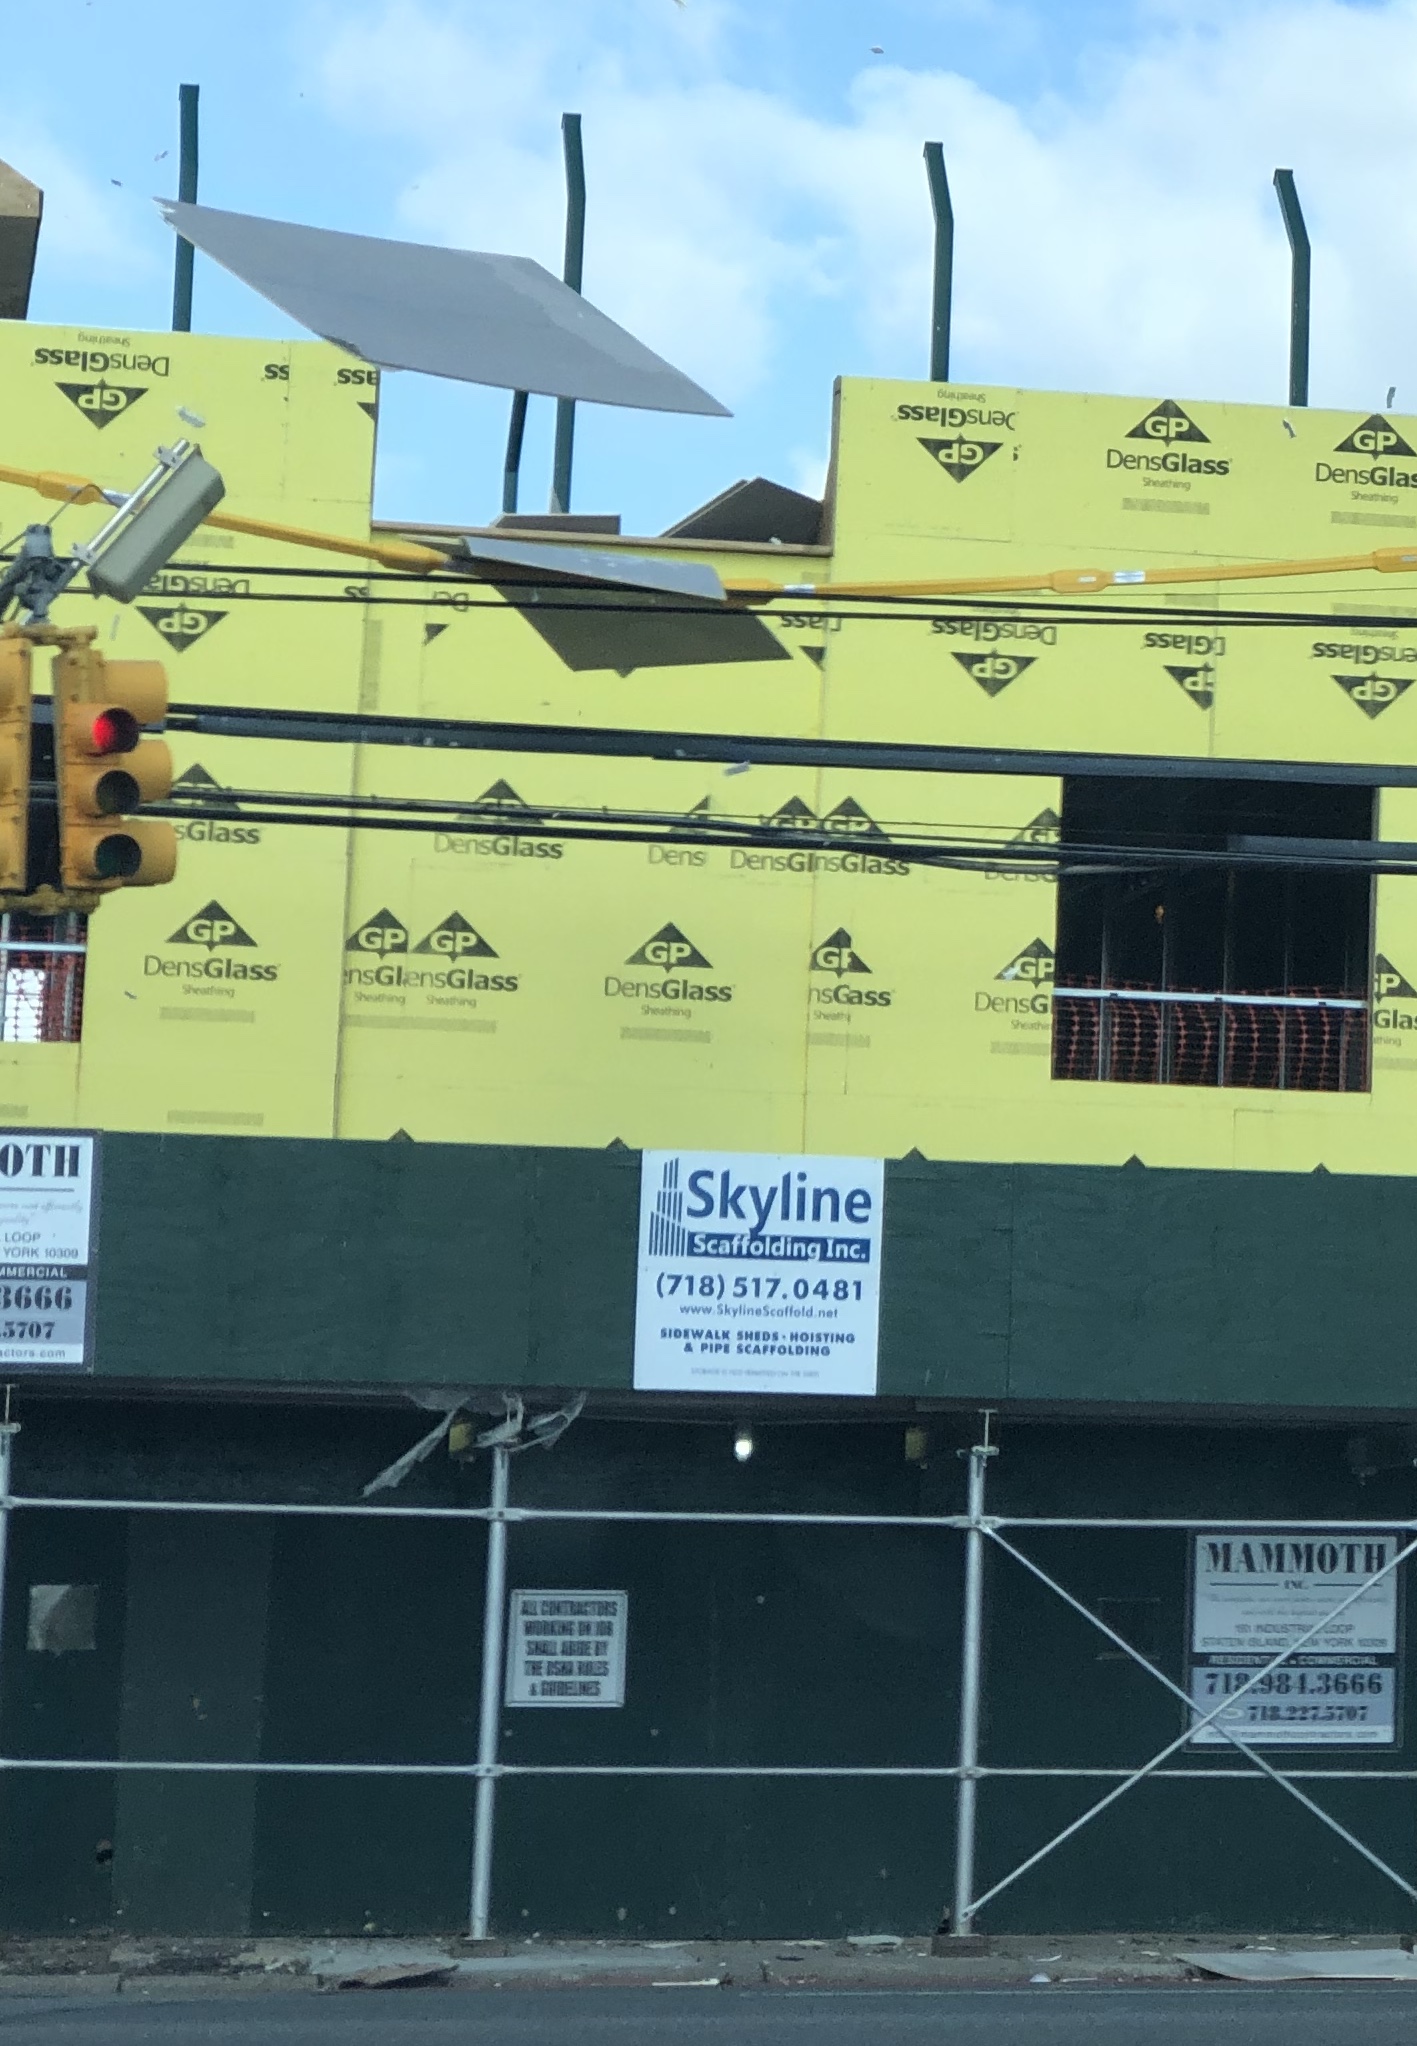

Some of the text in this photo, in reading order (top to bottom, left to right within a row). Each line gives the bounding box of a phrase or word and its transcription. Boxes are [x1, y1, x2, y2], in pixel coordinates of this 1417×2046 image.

[34, 347, 170, 377] DensGlass
[78, 391, 128, 411] GP
[1145, 416, 1190, 439] GP
[1352, 429, 1398, 452] GP
[938, 442, 984, 466] GP
[1107, 448, 1229, 476] DensGlass
[158, 611, 208, 634] GP
[930, 619, 1058, 645] DensGlass
[971, 658, 1018, 680] GP
[1351, 681, 1398, 702] GP
[433, 832, 563, 859] DensGlass
[648, 844, 706, 867] Dens
[185, 919, 236, 941] GP
[358, 927, 407, 950] GP
[429, 930, 478, 953] GP
[644, 942, 691, 964] GP
[144, 955, 278, 981] DensGlass
[604, 976, 733, 1002] DensGlass
[685, 1168, 872, 1236] Skyline
[4, 1232, 41, 1243] LOOP
[692, 1235, 867, 1261] Scaffolding Inc.
[4, 1246, 40, 1258] YORK
[656, 1271, 864, 1301] (718) 517.0481
[660, 1327, 856, 1343] SIDEWALK SHEDS HOISTING
[700, 1343, 730, 1354] PIPE
[736, 1343, 831, 1356] SCAFFOLDING
[1205, 1542, 1387, 1574] MAMMOTH
